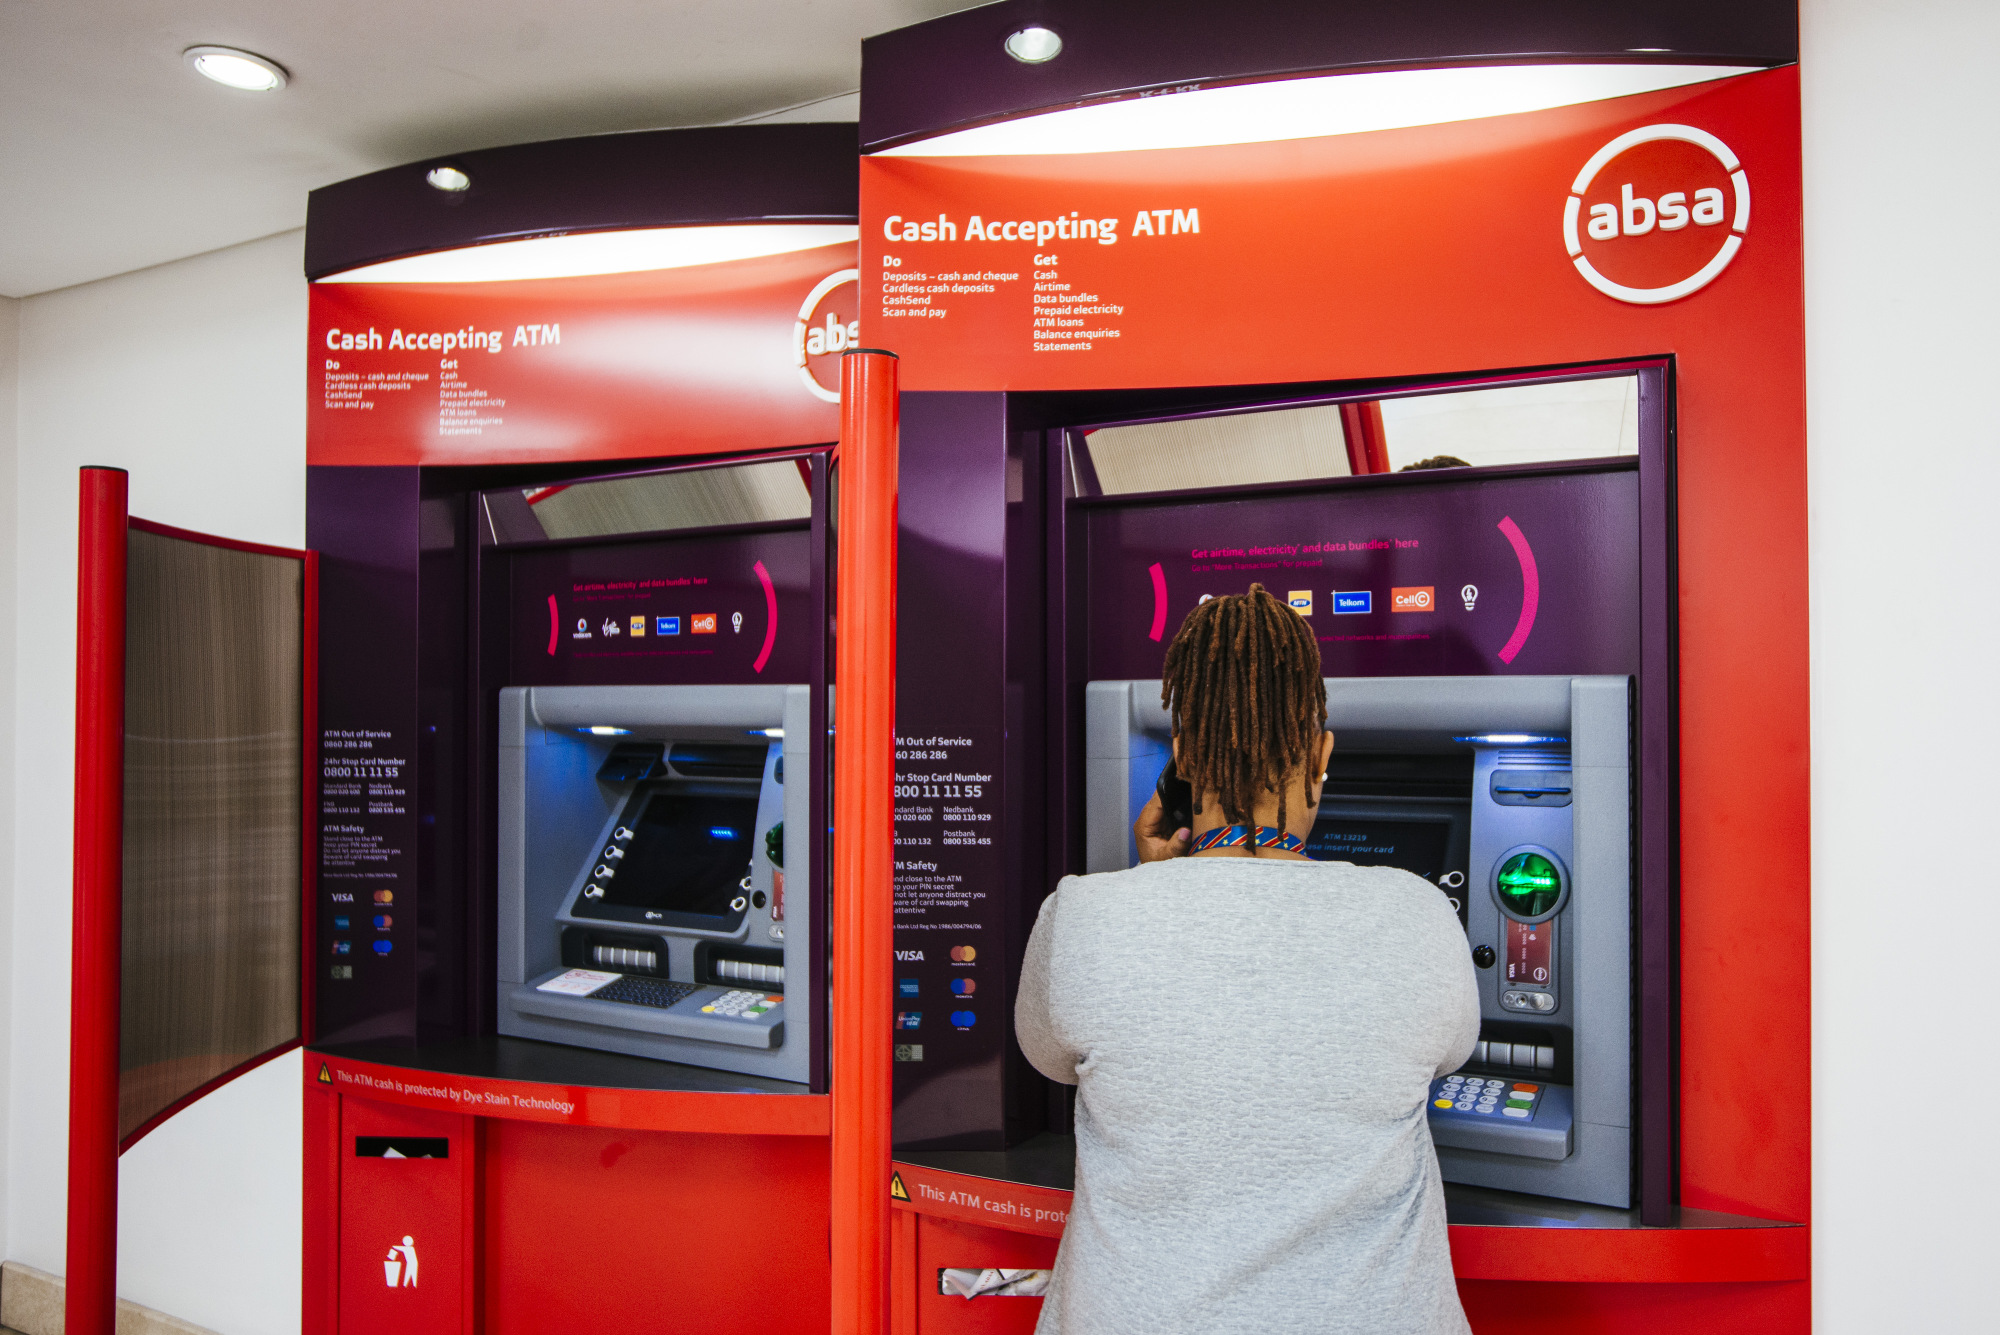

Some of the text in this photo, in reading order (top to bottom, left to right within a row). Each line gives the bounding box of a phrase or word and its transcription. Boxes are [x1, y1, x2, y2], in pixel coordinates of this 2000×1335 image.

[1587, 183, 1724, 240] absa
[884, 208, 1200, 246] Cash Accepting ATM
[883, 256, 901, 267] Do
[1034, 254, 1057, 265] Get
[883, 271, 1018, 282] Deposits cash and cheque
[1034, 270, 1057, 279] Cash
[883, 284, 995, 294] Cardless cash deposits
[1034, 282, 1070, 291] Airtime
[883, 295, 931, 304] CashSend
[1034, 293, 1098, 303] Data bundles
[883, 308, 946, 318] Scan and pay
[1034, 304, 1123, 316] Prepaid electricity
[1034, 317, 1083, 327] ATM loans
[1034, 328, 1120, 339] Balance enquiries
[326, 324, 560, 354] Cash Accepting ATM
[1034, 341, 1091, 351] Statements
[326, 360, 340, 369] Do
[440, 359, 458, 369] Get
[326, 372, 429, 381] Deposits cash and cheque
[326, 382, 358, 390] Cardless
[378, 382, 410, 391] deposits
[440, 381, 467, 389] Airtime
[440, 390, 457, 398] Data
[361, 402, 374, 410] pay
[1192, 550, 1208, 559] Get
[1210, 547, 1246, 558] airtime,
[1303, 543, 1321, 552] and
[1323, 542, 1346, 551] data
[1395, 539, 1418, 548] here
[324, 730, 391, 738] ATM Out of Service
[907, 737, 923, 746] Out
[926, 737, 936, 746] of
[938, 737, 972, 746] Service
[910, 751, 947, 759] 286 286
[342, 758, 358, 766] Stop
[324, 767, 398, 777] 0800 11 11 55
[907, 773, 991, 783] Stop Card Number
[894, 785, 981, 797] 800 11 11 55
[341, 825, 364, 833] Safety
[1324, 844, 1394, 854] insert your card
[907, 861, 937, 871] Safety
[332, 893, 354, 902] VISA
[936, 899, 968, 907] swapping
[894, 951, 924, 960] VISA
[337, 1070, 574, 1114] This ATM cash is protected by Dye Stain Technology
[918, 1184, 945, 1202] This
[949, 1191, 980, 1208] ATM
[984, 1200, 1016, 1215] cash
[1020, 1204, 1031, 1217] is
